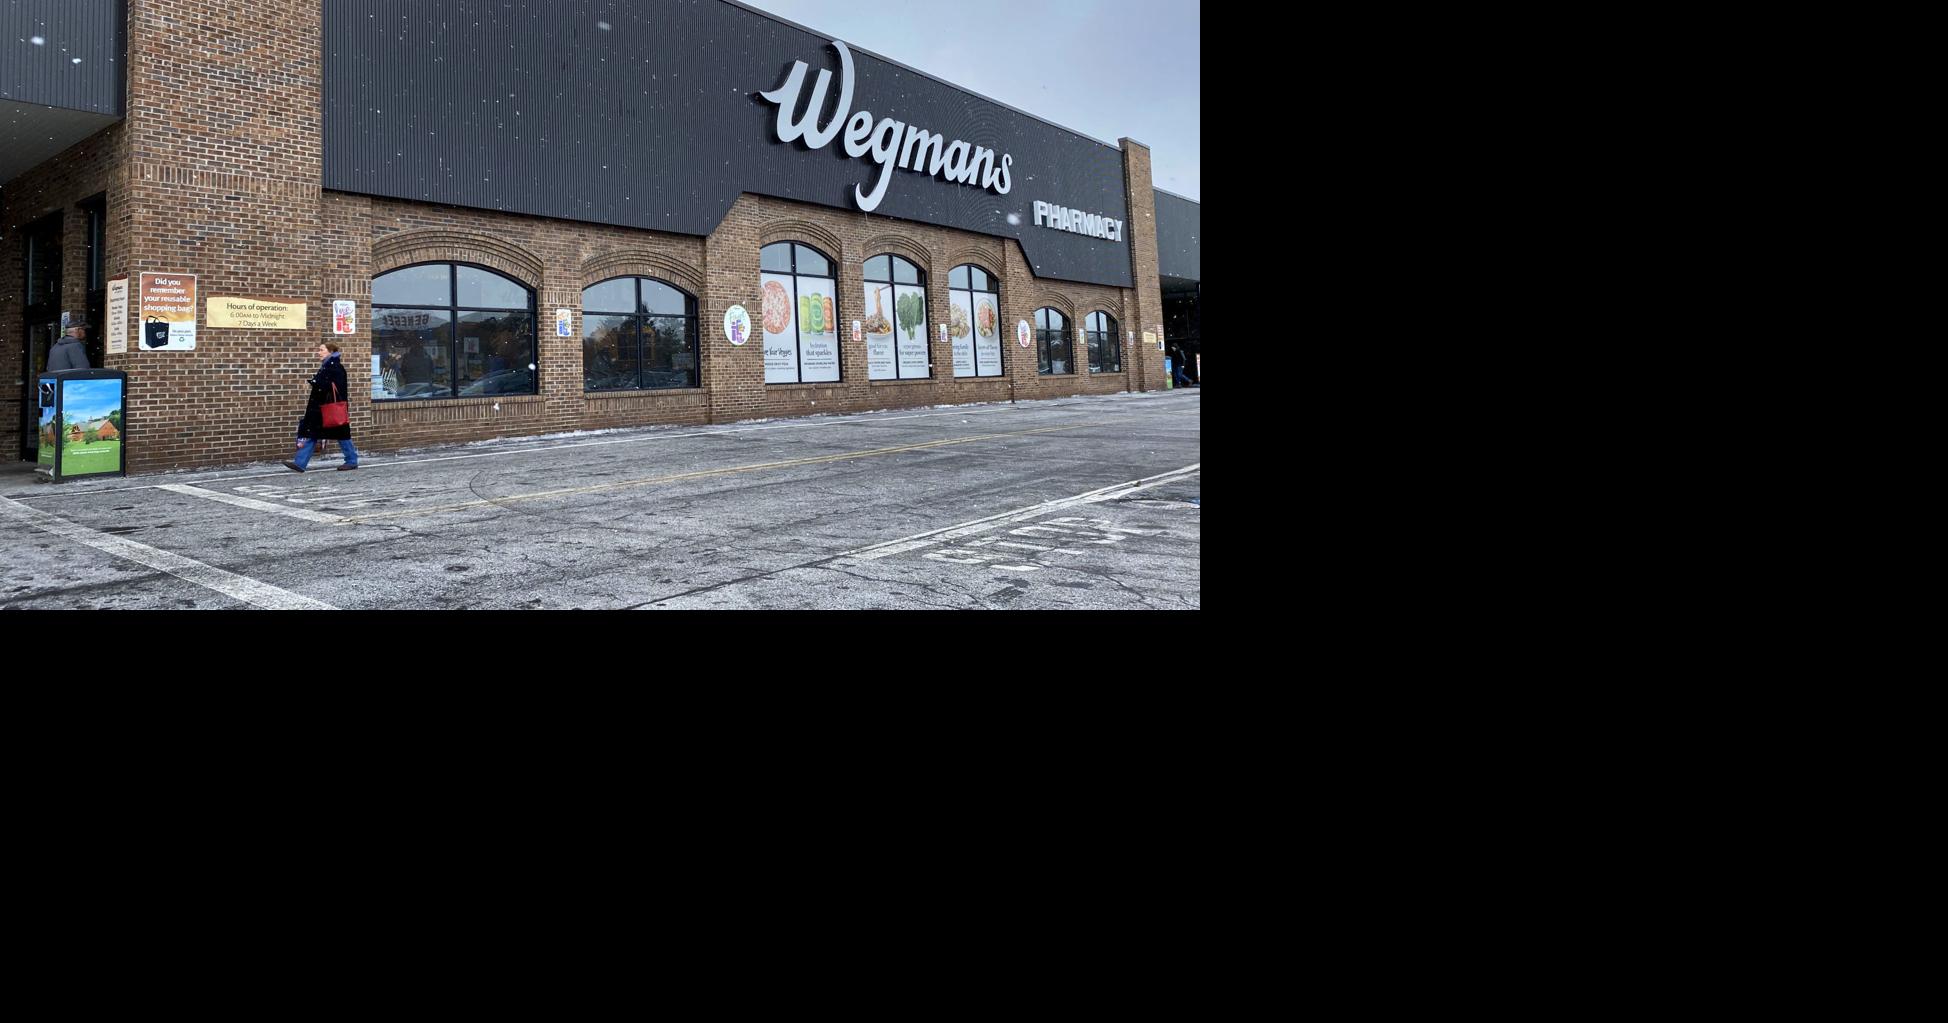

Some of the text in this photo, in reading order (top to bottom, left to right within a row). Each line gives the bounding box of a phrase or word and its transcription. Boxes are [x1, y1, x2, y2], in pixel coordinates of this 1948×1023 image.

[759, 41, 1012, 212] Wegmans
[1033, 200, 1123, 242] PHARMACY
[144, 304, 176, 312] shopping
[256, 304, 288, 312] operation:
